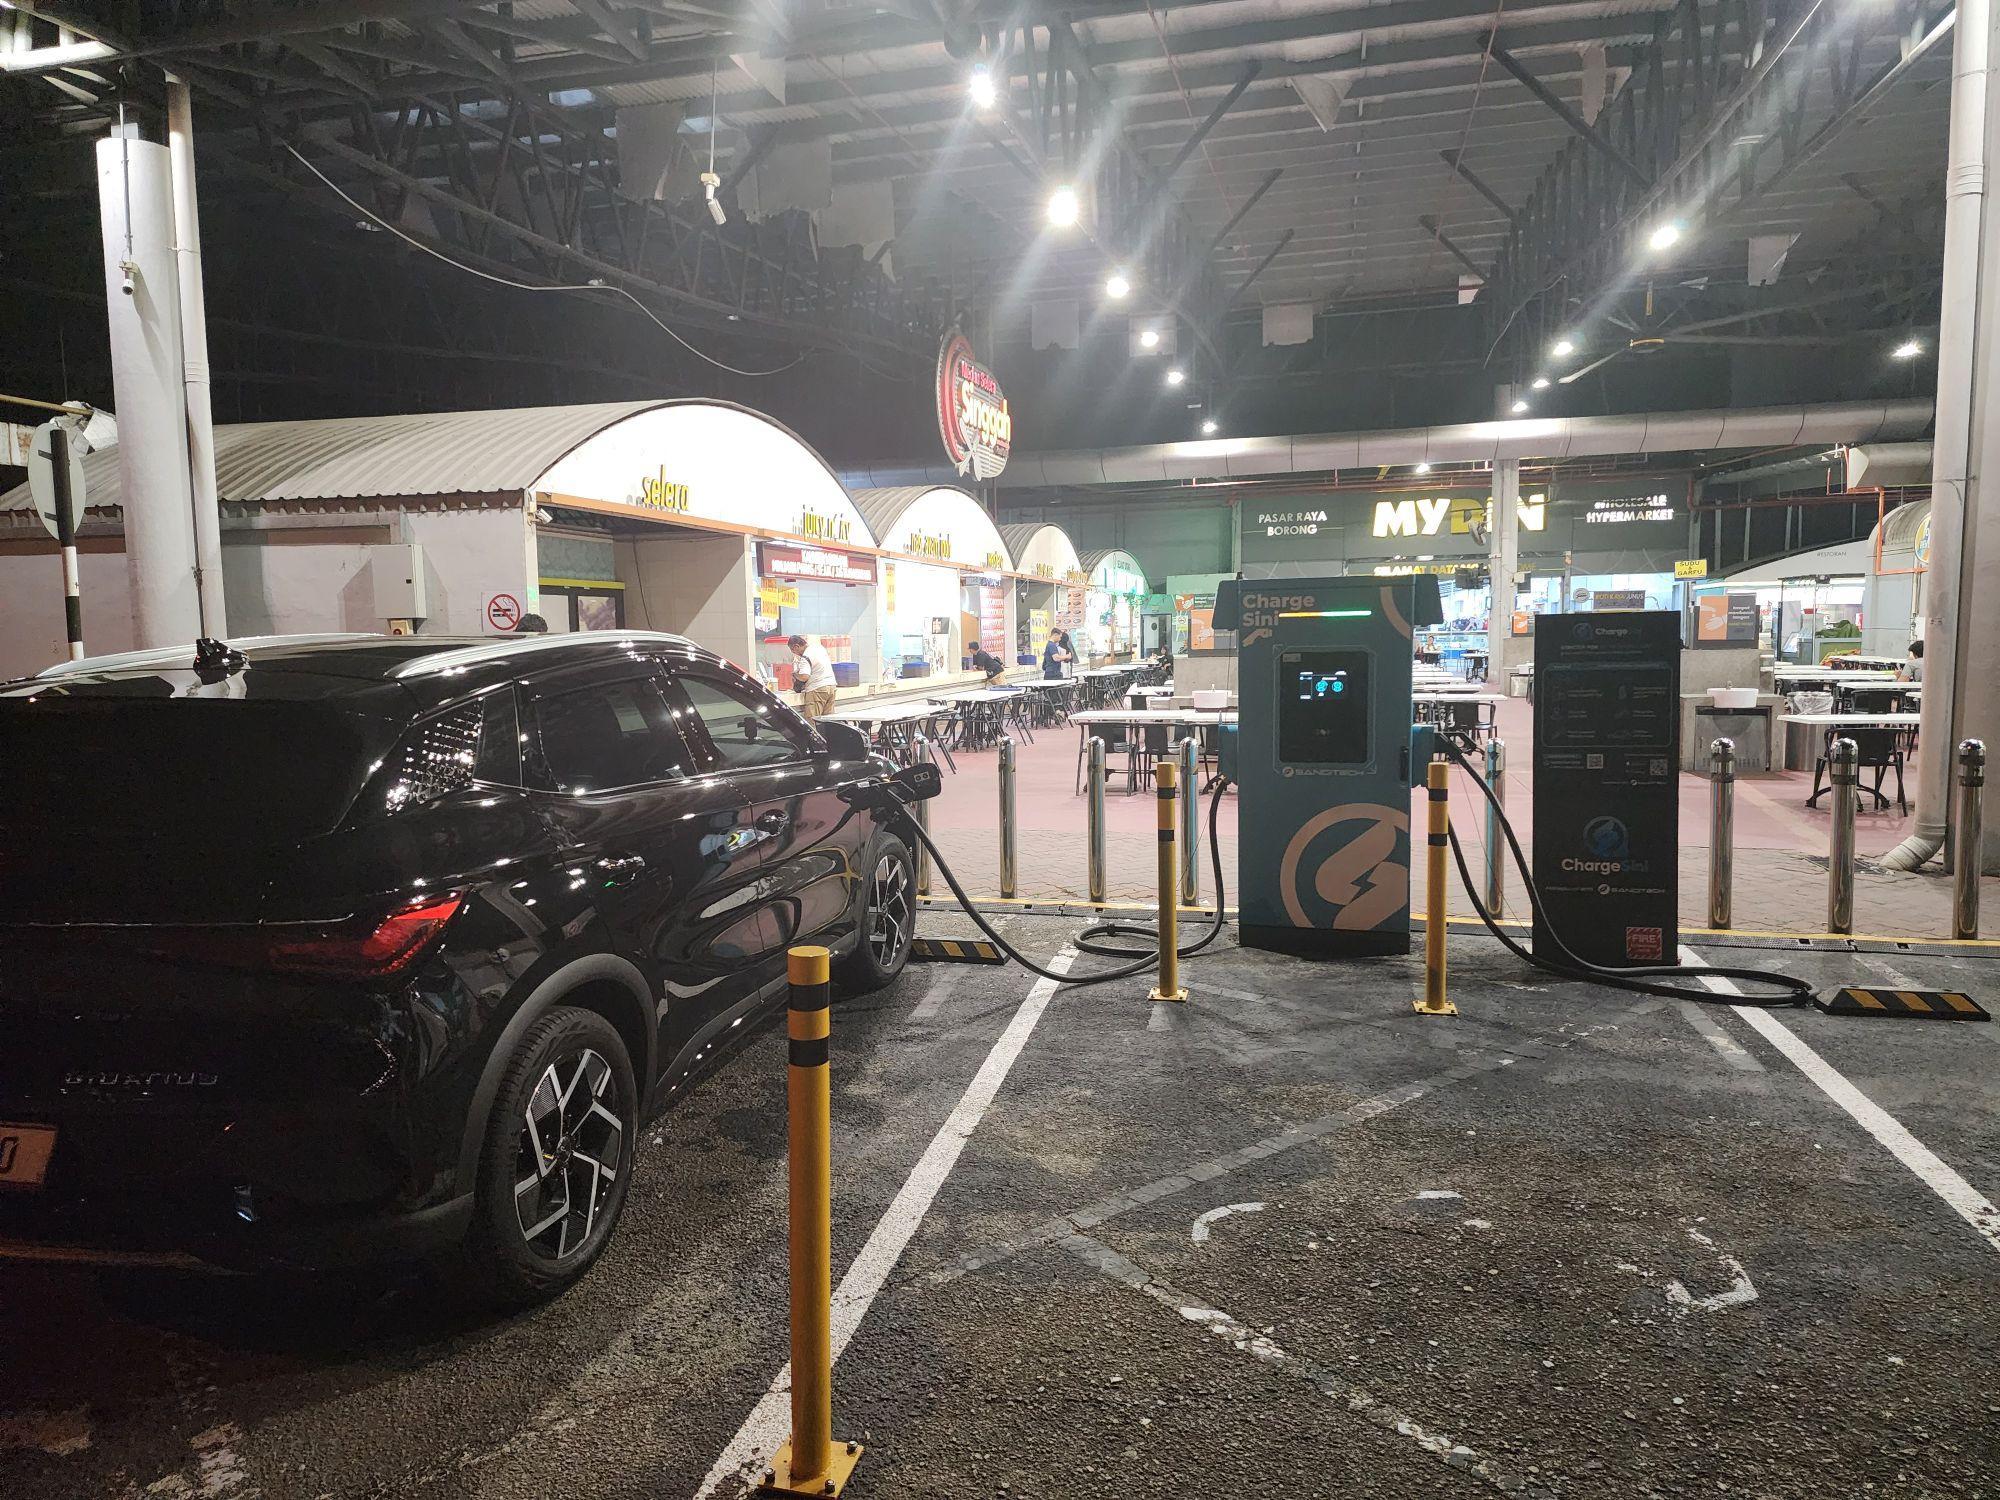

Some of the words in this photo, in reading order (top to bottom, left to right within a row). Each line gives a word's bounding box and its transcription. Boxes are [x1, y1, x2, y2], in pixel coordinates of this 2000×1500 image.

[961, 380, 1011, 447] Singgah
[641, 463, 690, 512] selera
[1258, 512, 1294, 524] PASAR
[1296, 510, 1328, 522] RAYA
[1586, 508, 1675, 523] HYPERMARKET
[1266, 523, 1318, 537] BORONG
[1242, 594, 1315, 610] Charge
[1242, 612, 1280, 627] Sini
[1632, 934, 1657, 943] FIRE
